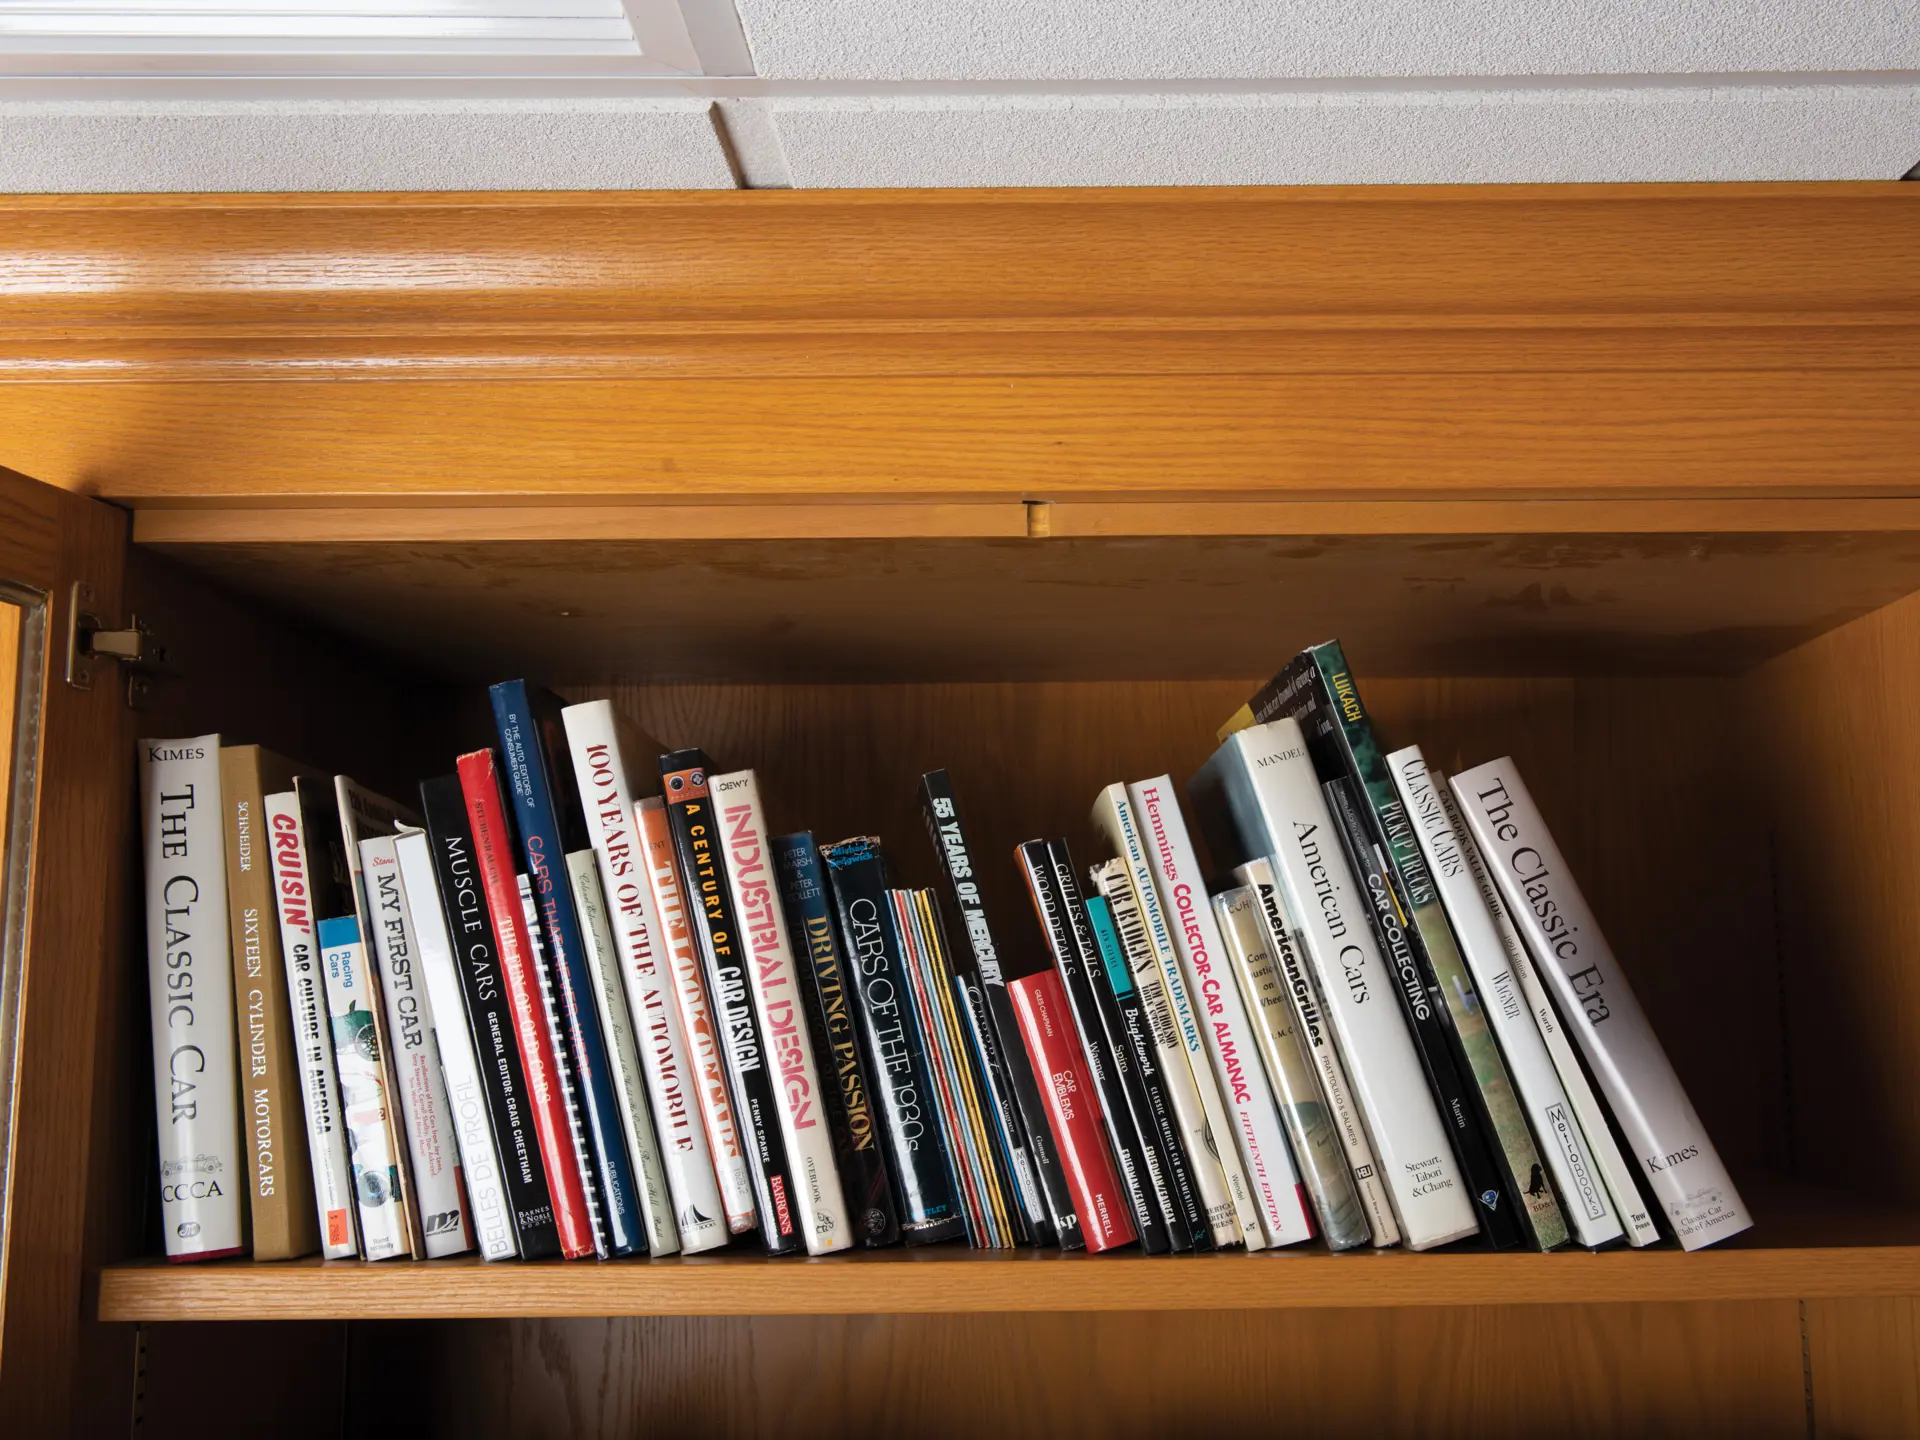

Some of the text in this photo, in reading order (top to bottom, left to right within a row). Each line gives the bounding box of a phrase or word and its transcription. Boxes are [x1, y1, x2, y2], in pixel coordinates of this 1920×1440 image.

[1332, 672, 1362, 722] LUKACH
[148, 747, 205, 763] KIMES
[504, 728, 519, 772] CONSUMER
[508, 714, 535, 808] BY THE AUTO EDITORS OF
[1257, 748, 1305, 769] MANDEL
[715, 778, 748, 793] LOEWY
[932, 797, 955, 818] 55
[237, 801, 251, 873] SCHNEIDER
[1401, 758, 1464, 878] CLASSIC CARS
[272, 813, 311, 934] CRUISIN'
[372, 857, 395, 868] Stone
[783, 847, 806, 858] PETER
[783, 857, 813, 870] MARSH
[940, 821, 972, 878] YEARS
[1379, 801, 1436, 904] PICKUP TRUCKS
[1438, 789, 1504, 921] CAR BOOK VALUE GUIDE
[527, 835, 553, 894] CARS
[543, 897, 564, 949] THAT
[790, 878, 813, 890] PETER
[796, 870, 804, 879] &
[957, 881, 980, 906] OF
[1104, 872, 1133, 906] CAR
[1033, 863, 1076, 978] WOOD DETAILS
[1056, 863, 1101, 979] GRILLES & TAILS
[1293, 821, 1370, 1005] American Cars
[1476, 777, 1611, 1028] The Classic Era
[498, 915, 517, 948] THE
[586, 744, 694, 1152] 100 YEARS OF THE AUTOMOBILE
[685, 804, 761, 1073] A CENTURY OF CAR DESIGN
[964, 908, 1005, 987] MERCURY
[1116, 801, 1200, 1053] American AUTOMOBILE TRADEMARKS
[1367, 873, 1430, 1021] CAR COLLECTING
[160, 784, 205, 1125] THE CLASSIC CAR
[292, 943, 310, 972] CAR
[328, 953, 341, 979] Cars
[339, 951, 352, 988] Racing
[377, 872, 423, 1050] MY FIRST CAR
[724, 804, 816, 1130] INDUSTRIAL DESIGN
[1504, 935, 1528, 979] 1991 Edition
[296, 974, 319, 1040] CULTURE
[445, 837, 533, 1184] MUSCLE CARS GENERAL EDITOR: CRAIG CHEETHAM
[513, 991, 533, 1014] OF
[1034, 989, 1054, 1038] GILES CHAPMAN
[1143, 787, 1283, 1232] Hemmings COLLECTOR-CAR ALMANAC FIFTEENTH EDITION
[1148, 979, 1180, 1049] TIM NICHOLSON
[1491, 970, 1520, 1021] WAGNER
[519, 1018, 540, 1054] OLD
[807, 913, 850, 1034] DRIVING
[834, 1041, 875, 1151] PASSION
[849, 898, 924, 1153] CARS OF THE 1930s
[1539, 1008, 1554, 1034] Warth
[243, 908, 274, 1197] SIXTEEN CYLINDER MOTORCARS
[306, 1045, 322, 1063] IN
[1114, 1043, 1128, 1074] Spiro
[308, 1068, 332, 1136] AMERICA
[528, 1057, 551, 1104] CARS
[1053, 1072, 1075, 1121] EMBLEMS
[1062, 1070, 1077, 1093] CAR
[1321, 1055, 1358, 1147] FRATTOLILLO & SALMIERI
[750, 1098, 770, 1164] PENNY SPARKE
[1001, 1099, 1015, 1133] Wagner
[1124, 1007, 1198, 1223] Brightwork CLASSIC AMERICAN CAR ORNAMENTATION
[1450, 1098, 1465, 1129] Martin
[806, 1156, 822, 1204] OVERLOOK
[1405, 1156, 1442, 1173] Stewart,
[1412, 1167, 1442, 1184] Tabori
[1645, 1143, 1699, 1174] Kimes
[162, 1180, 224, 1203] CCCA
[468, 1151, 507, 1255] BELLES DE
[608, 1161, 625, 1216] PUBLICATIONS
[772, 1176, 792, 1236] BARRON'S
[1121, 1148, 1151, 1228] FRIEDMAN/FAIRFAX
[1146, 1145, 1176, 1224] FRIEDMAN/FAIRFAX
[1231, 1173, 1245, 1201] Wendel
[1412, 1178, 1453, 1198] & Chang
[519, 1206, 550, 1218] BARNES
[527, 1211, 550, 1223] NOBLE
[1058, 1213, 1077, 1231] kp
[1095, 1193, 1113, 1238] MERRELL
[1631, 1212, 1646, 1222] Tew
[1635, 1221, 1651, 1231] Press
[1677, 1210, 1736, 1237] Club of America
[1680, 1205, 1722, 1227] Classic Car
